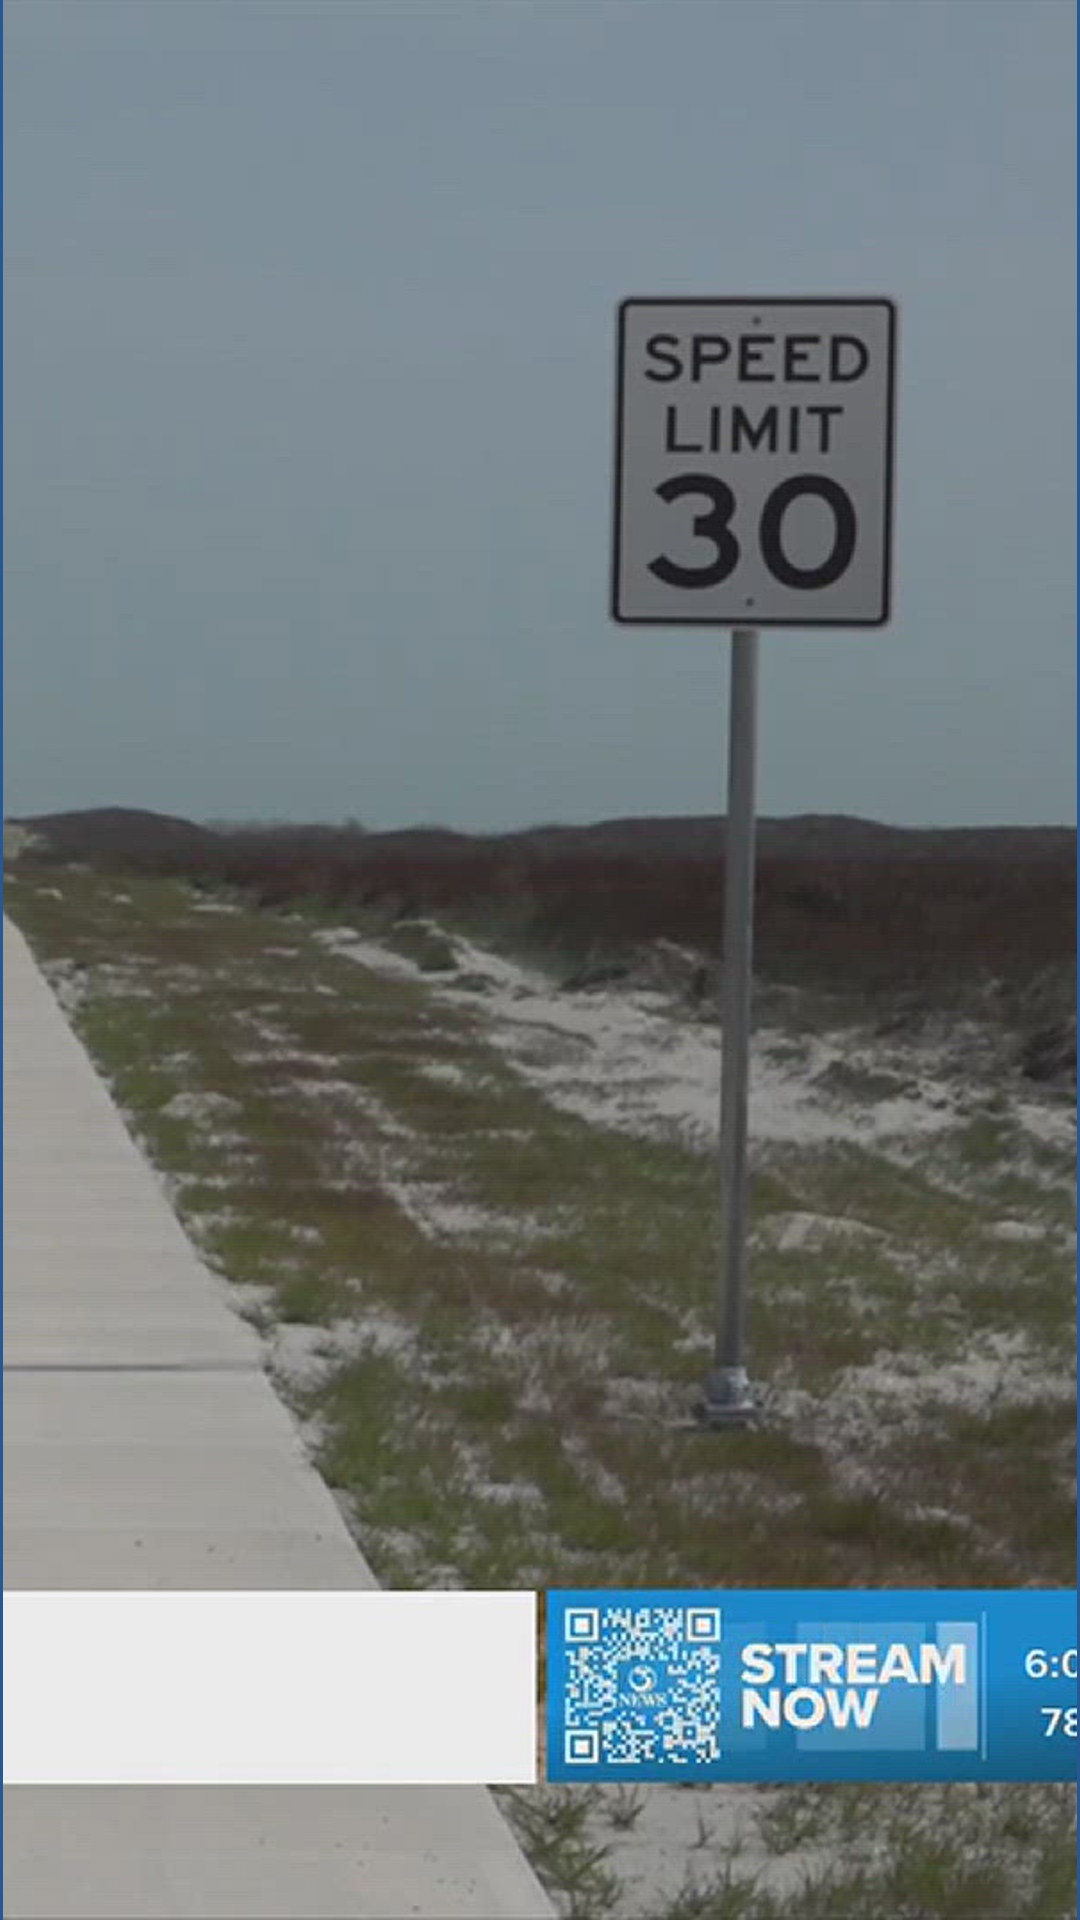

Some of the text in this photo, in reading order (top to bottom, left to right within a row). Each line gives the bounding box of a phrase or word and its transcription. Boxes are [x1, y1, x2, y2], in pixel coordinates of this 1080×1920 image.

[645, 333, 870, 383] SPEED
[665, 405, 844, 454] LIMIT
[646, 472, 857, 591] 30
